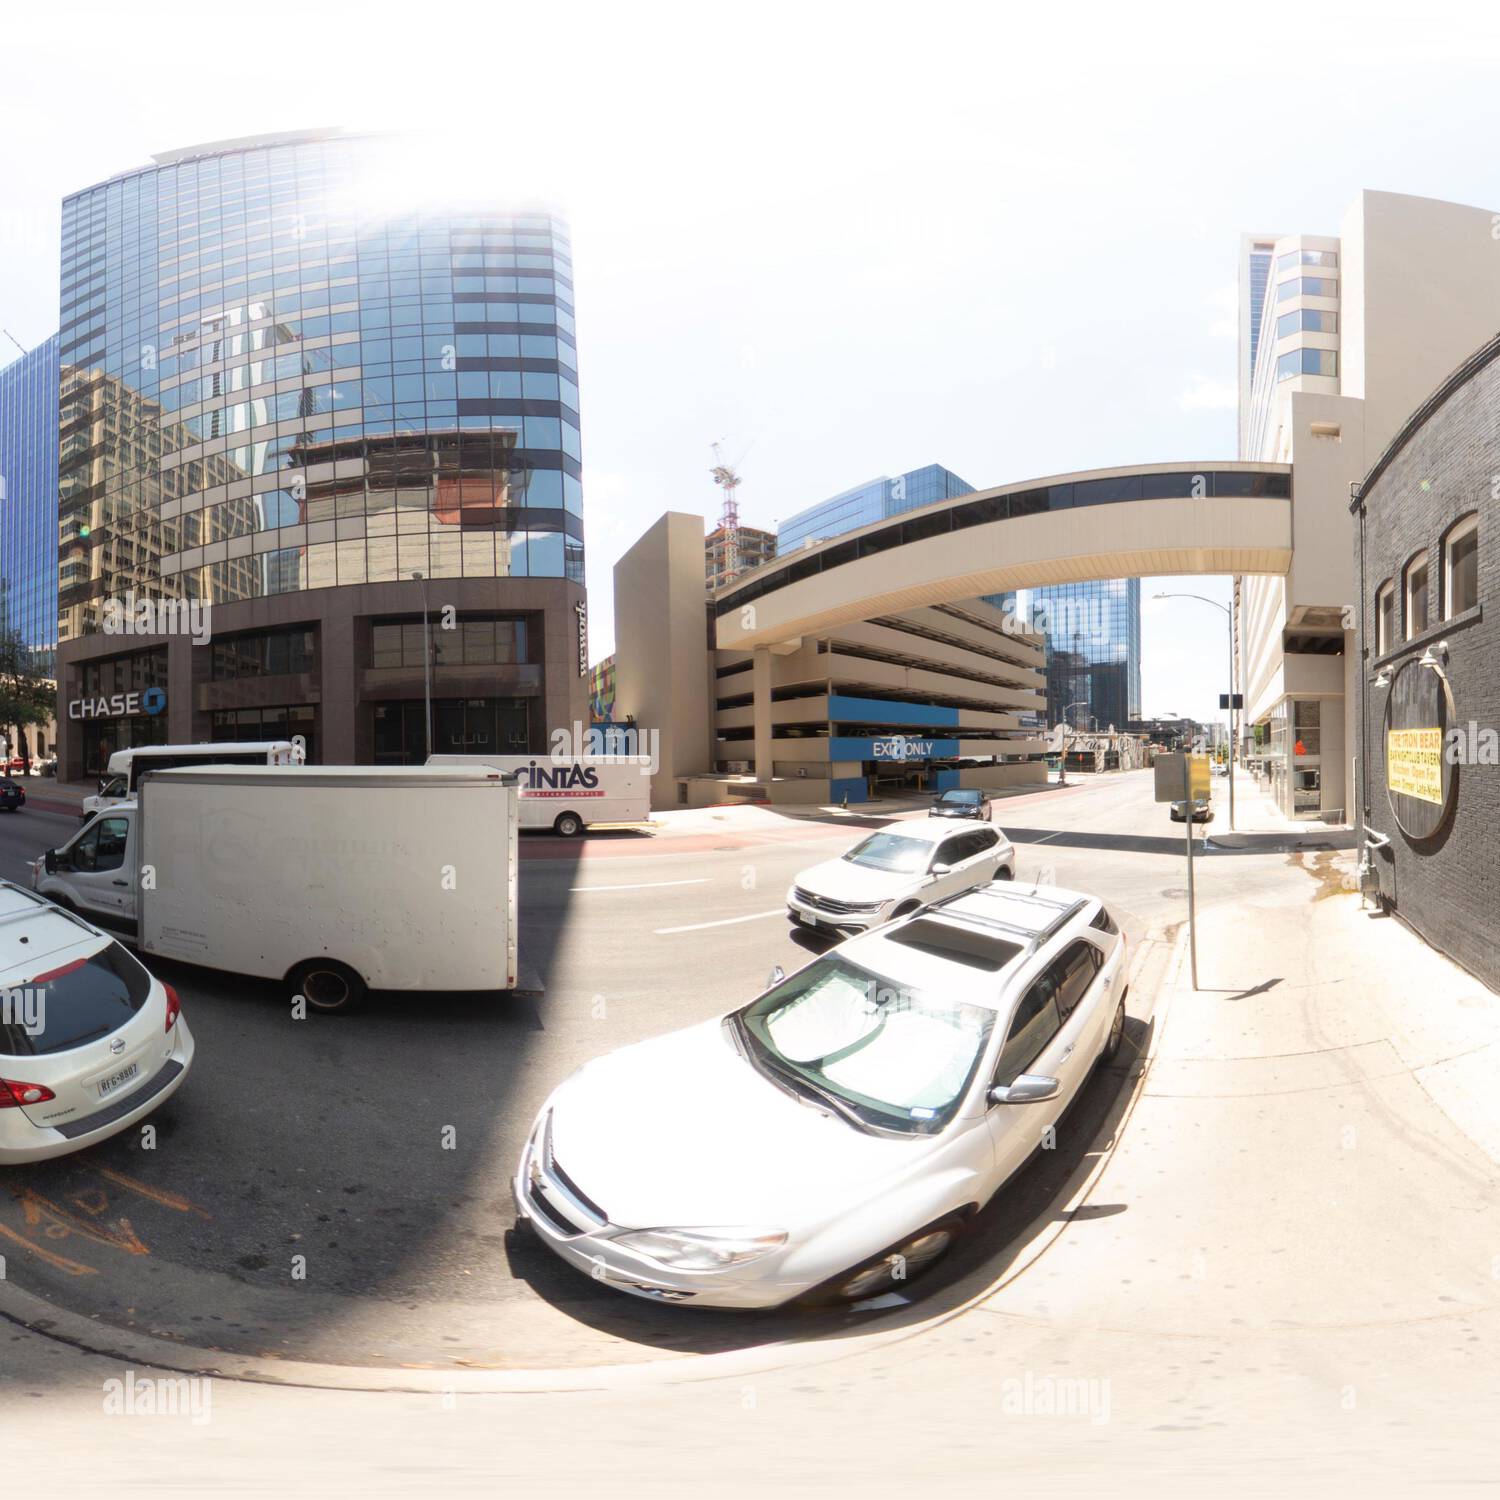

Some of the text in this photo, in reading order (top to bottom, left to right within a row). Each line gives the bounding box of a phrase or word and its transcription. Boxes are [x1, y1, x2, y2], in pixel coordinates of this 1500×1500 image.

[68, 692, 141, 719] CHASE
[905, 742, 933, 755] ONLY
[1419, 732, 1440, 749] BEAR
[514, 760, 599, 789] CINTAS
